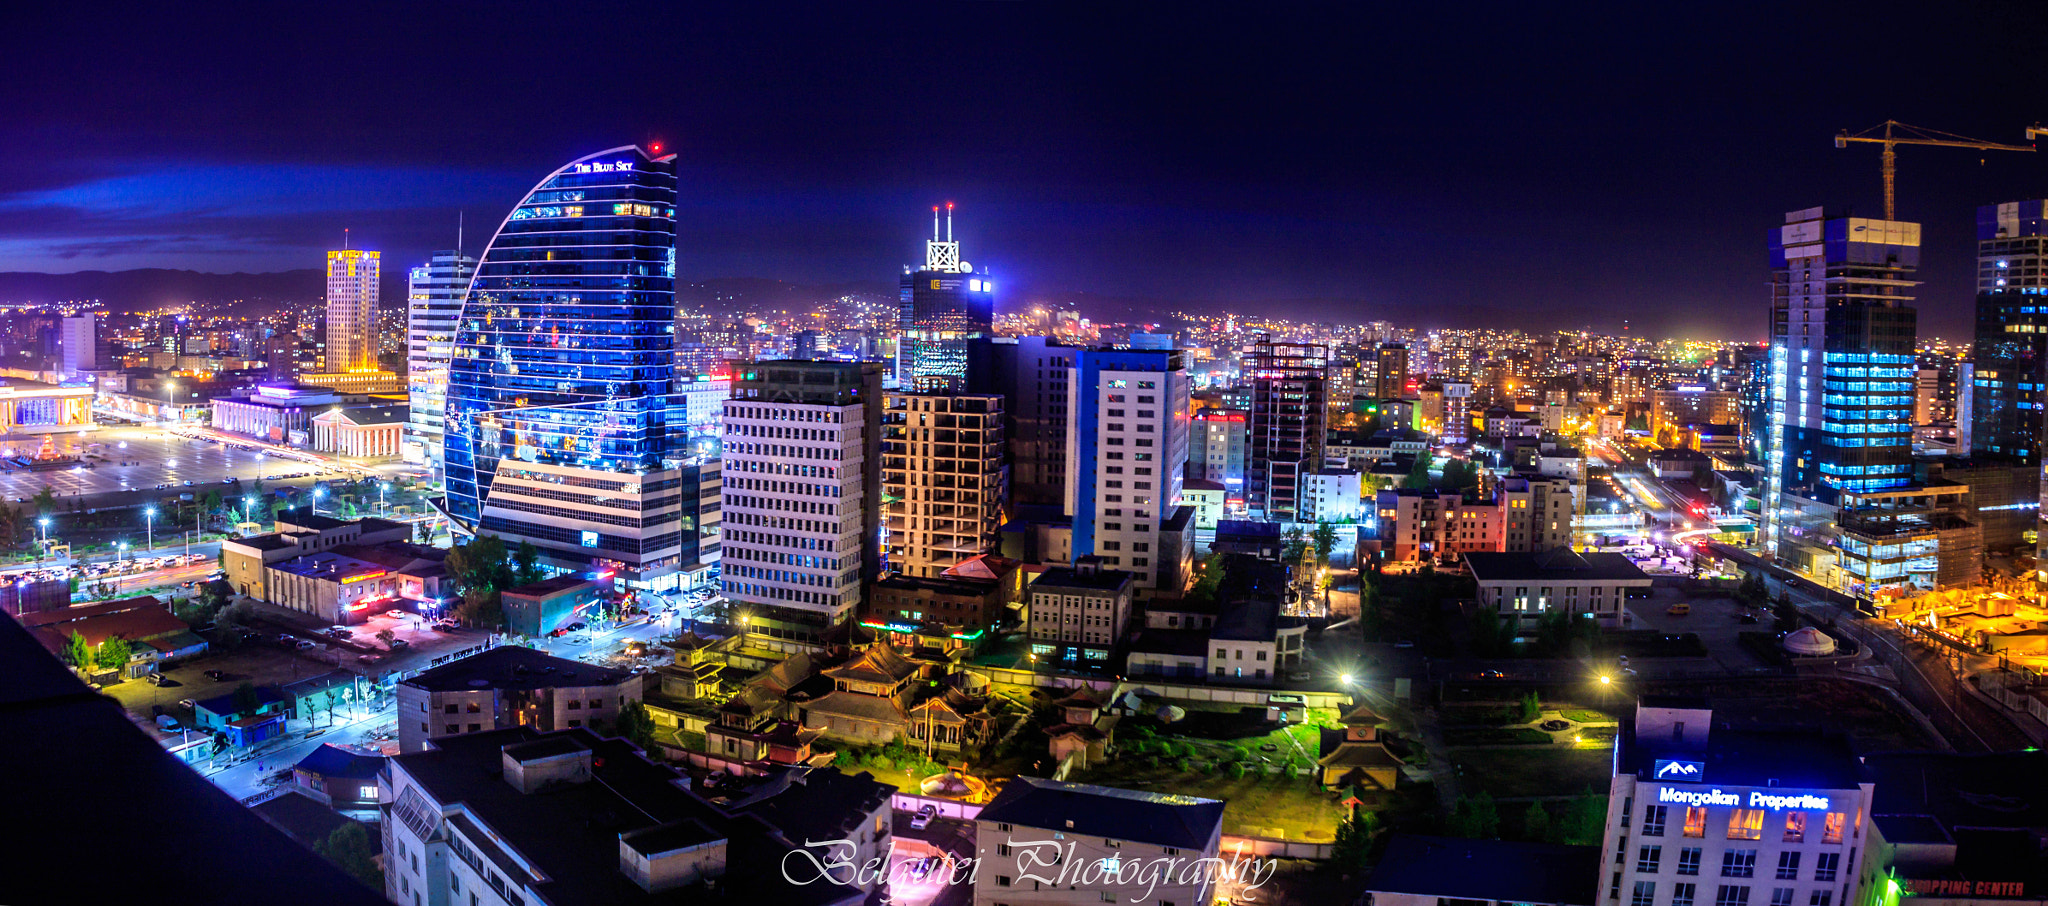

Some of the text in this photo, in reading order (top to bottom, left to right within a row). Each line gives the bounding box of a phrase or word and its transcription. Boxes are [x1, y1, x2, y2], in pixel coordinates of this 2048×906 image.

[1659, 787, 1829, 811] Mongolian Properties
[1905, 879, 2024, 897] SHOPPING CENTER
